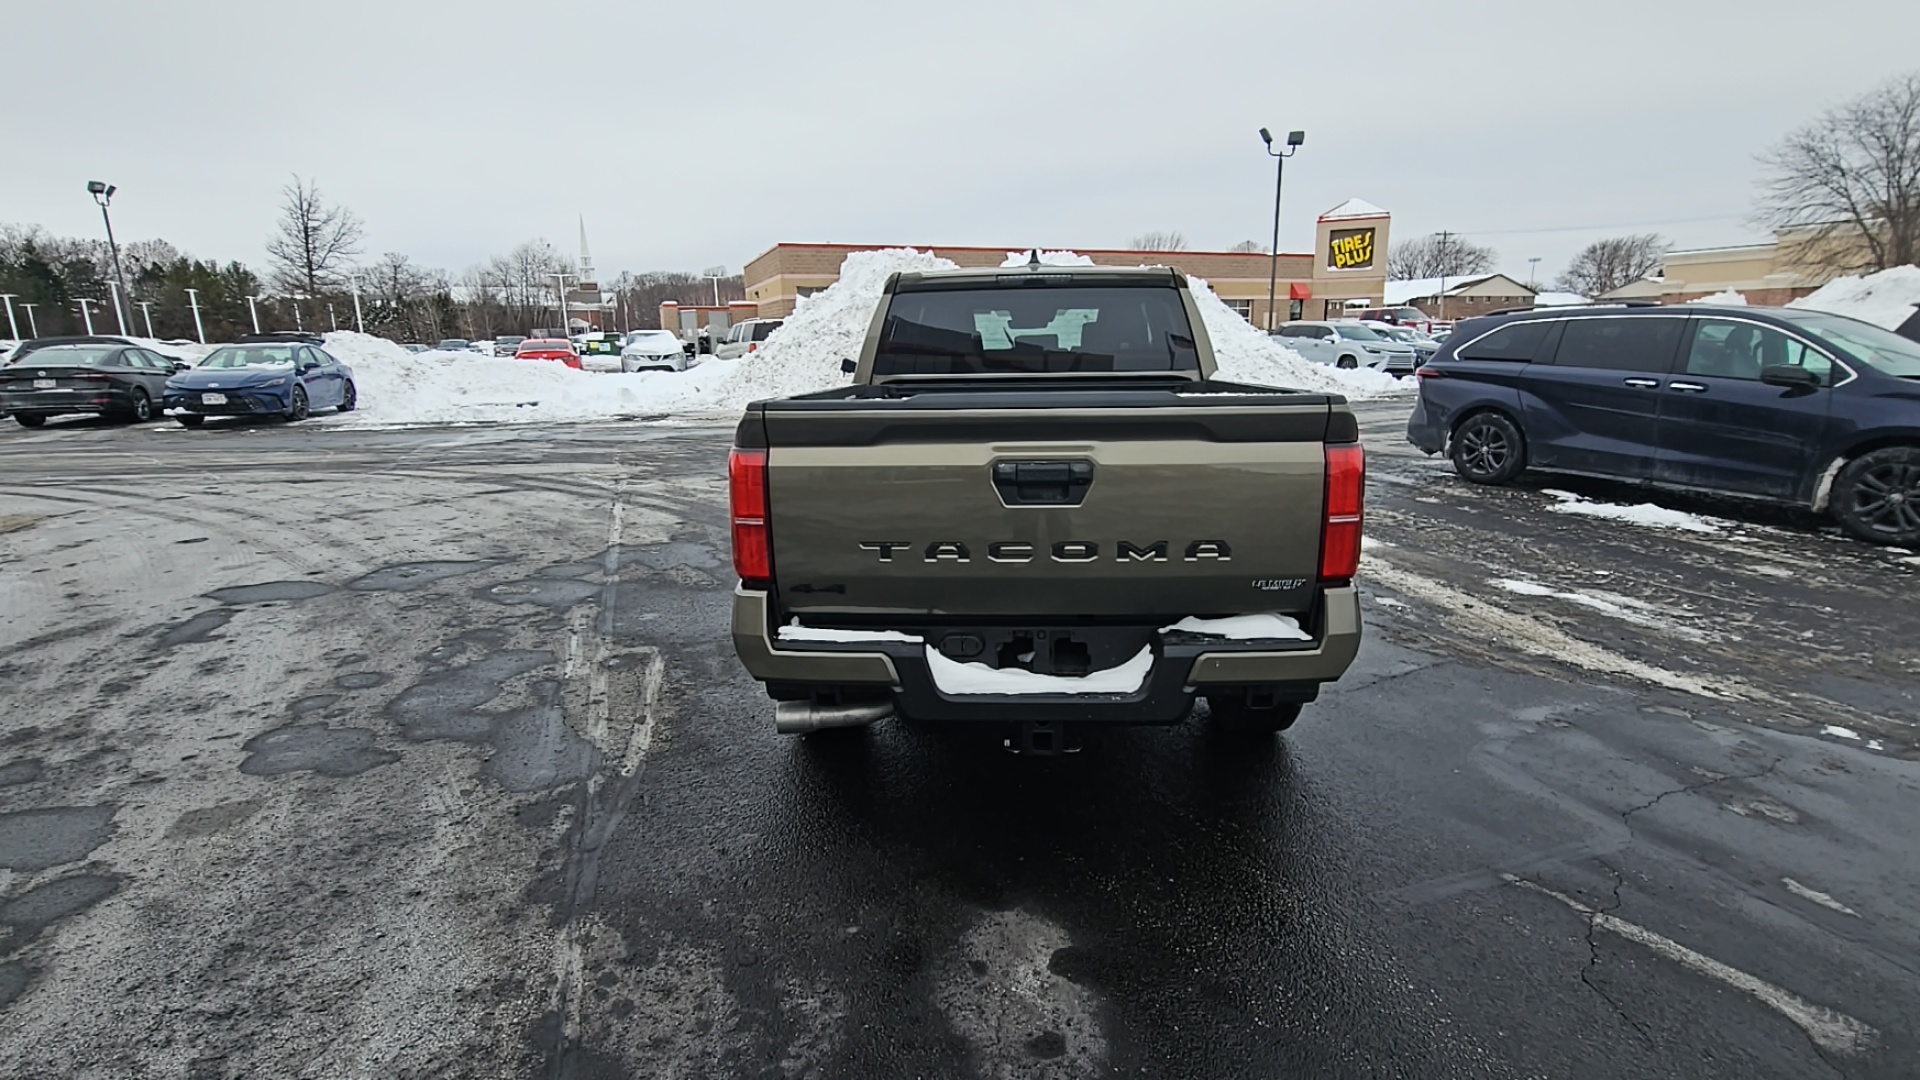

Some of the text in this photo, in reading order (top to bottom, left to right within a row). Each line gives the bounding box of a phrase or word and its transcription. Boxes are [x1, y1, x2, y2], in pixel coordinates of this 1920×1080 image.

[1331, 231, 1372, 255] TIRES
[1335, 245, 1372, 268] PLUS
[859, 540, 1232, 563] TACOMA
